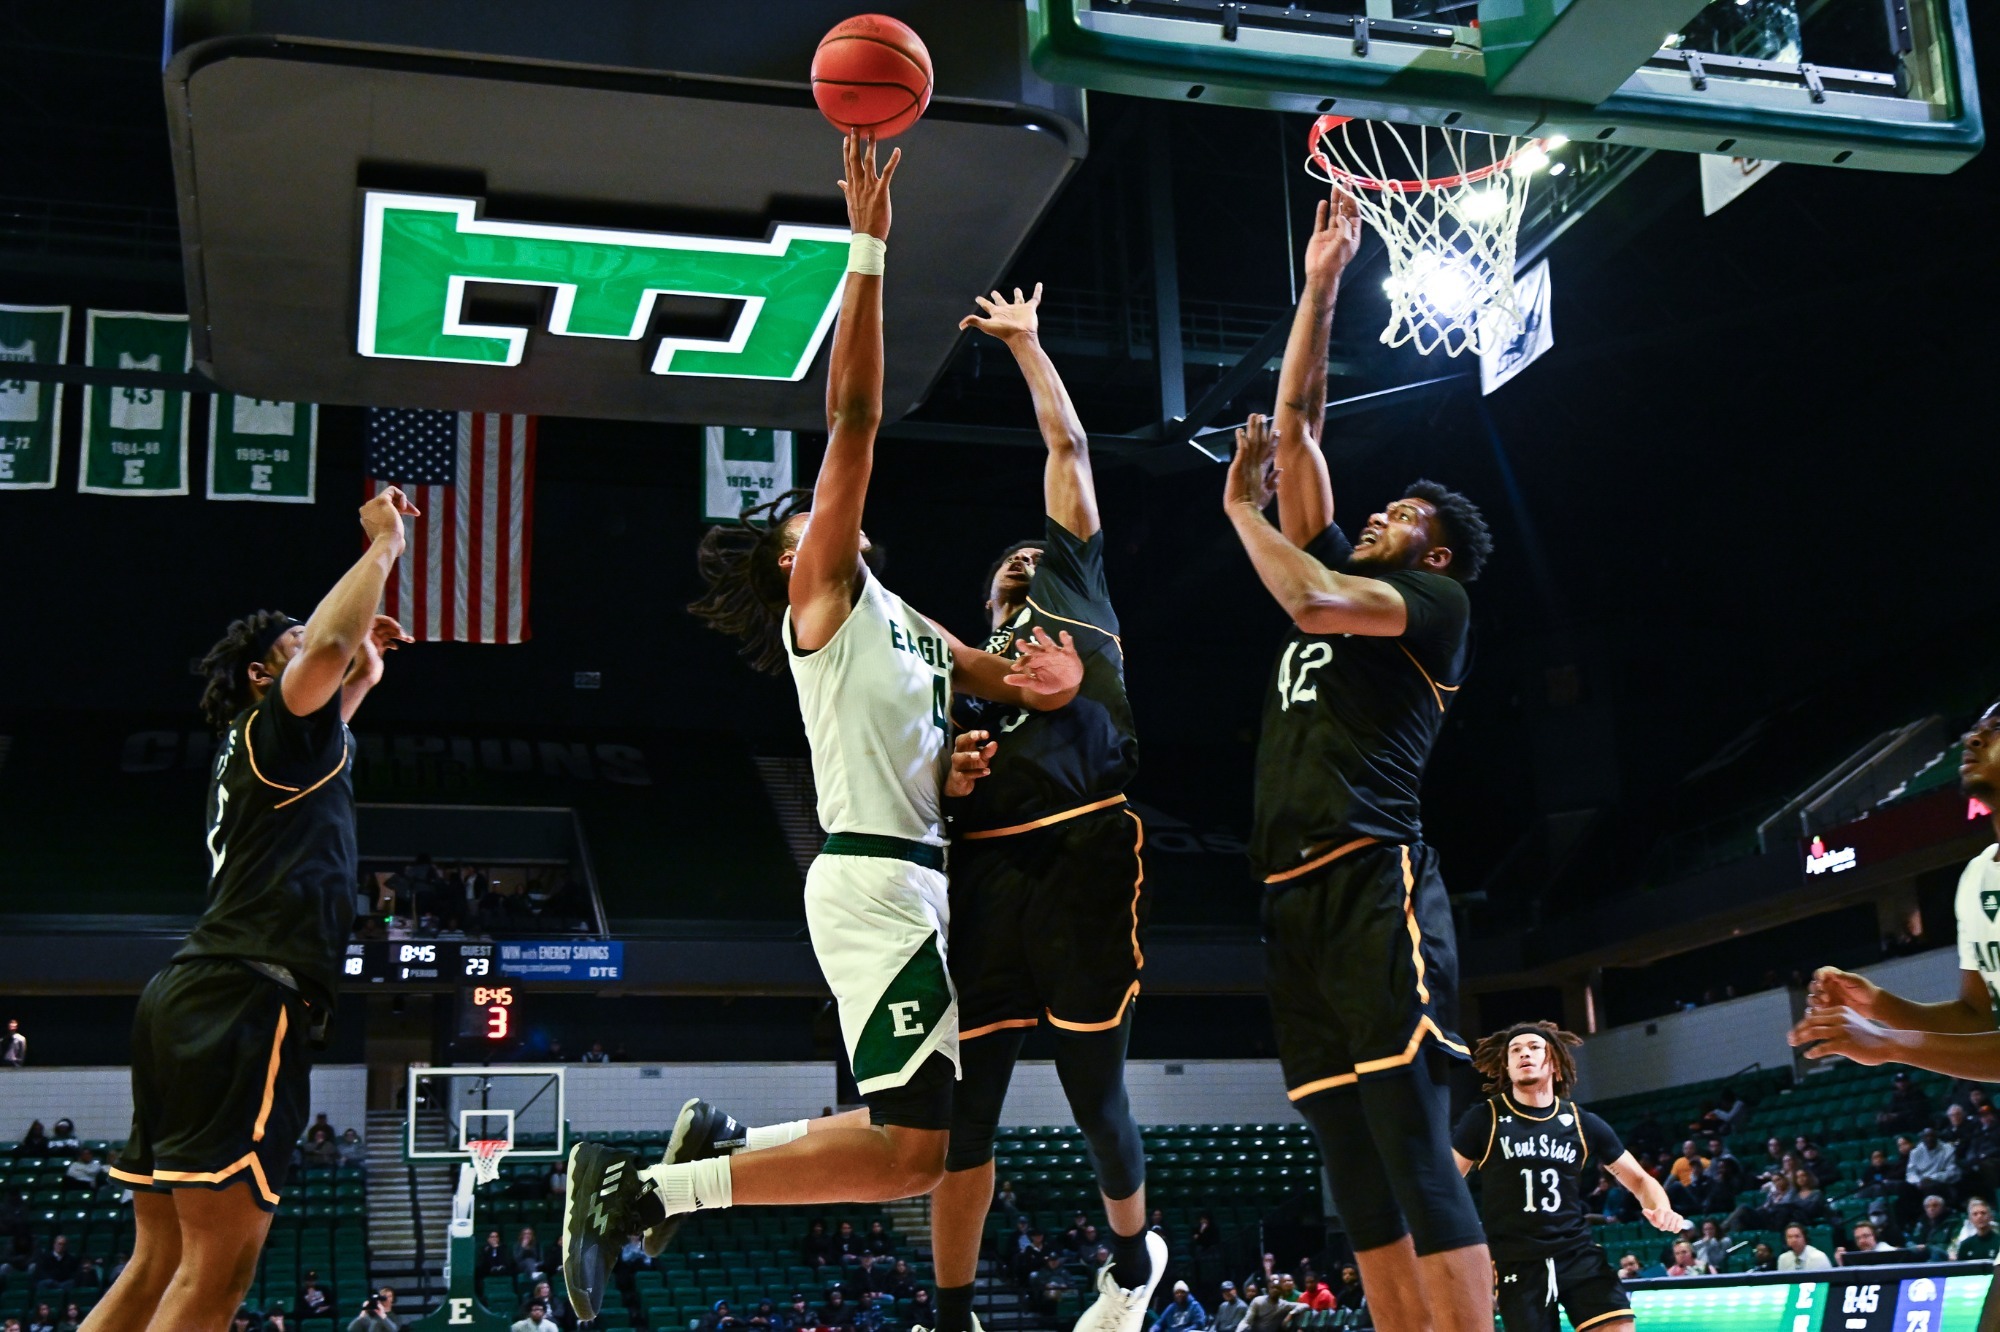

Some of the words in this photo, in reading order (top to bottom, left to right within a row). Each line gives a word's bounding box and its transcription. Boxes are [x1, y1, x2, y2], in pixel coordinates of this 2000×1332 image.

[357, 192, 851, 382] E
[122, 459, 145, 485] E
[250, 464, 273, 491] E
[889, 619, 953, 669] EAGL
[1278, 641, 1333, 712] 42
[400, 944, 436, 963] 8:45
[460, 945, 492, 957] GUEST
[466, 958, 490, 976] 23
[589, 966, 618, 978] DTE
[474, 987, 513, 1006] 8:45
[487, 1006, 508, 1039] 3
[888, 1000, 925, 1038] E
[1500, 1135, 1537, 1160] Kent
[1539, 1134, 1577, 1164] State
[1520, 1168, 1562, 1213] 13
[448, 1298, 473, 1325] E
